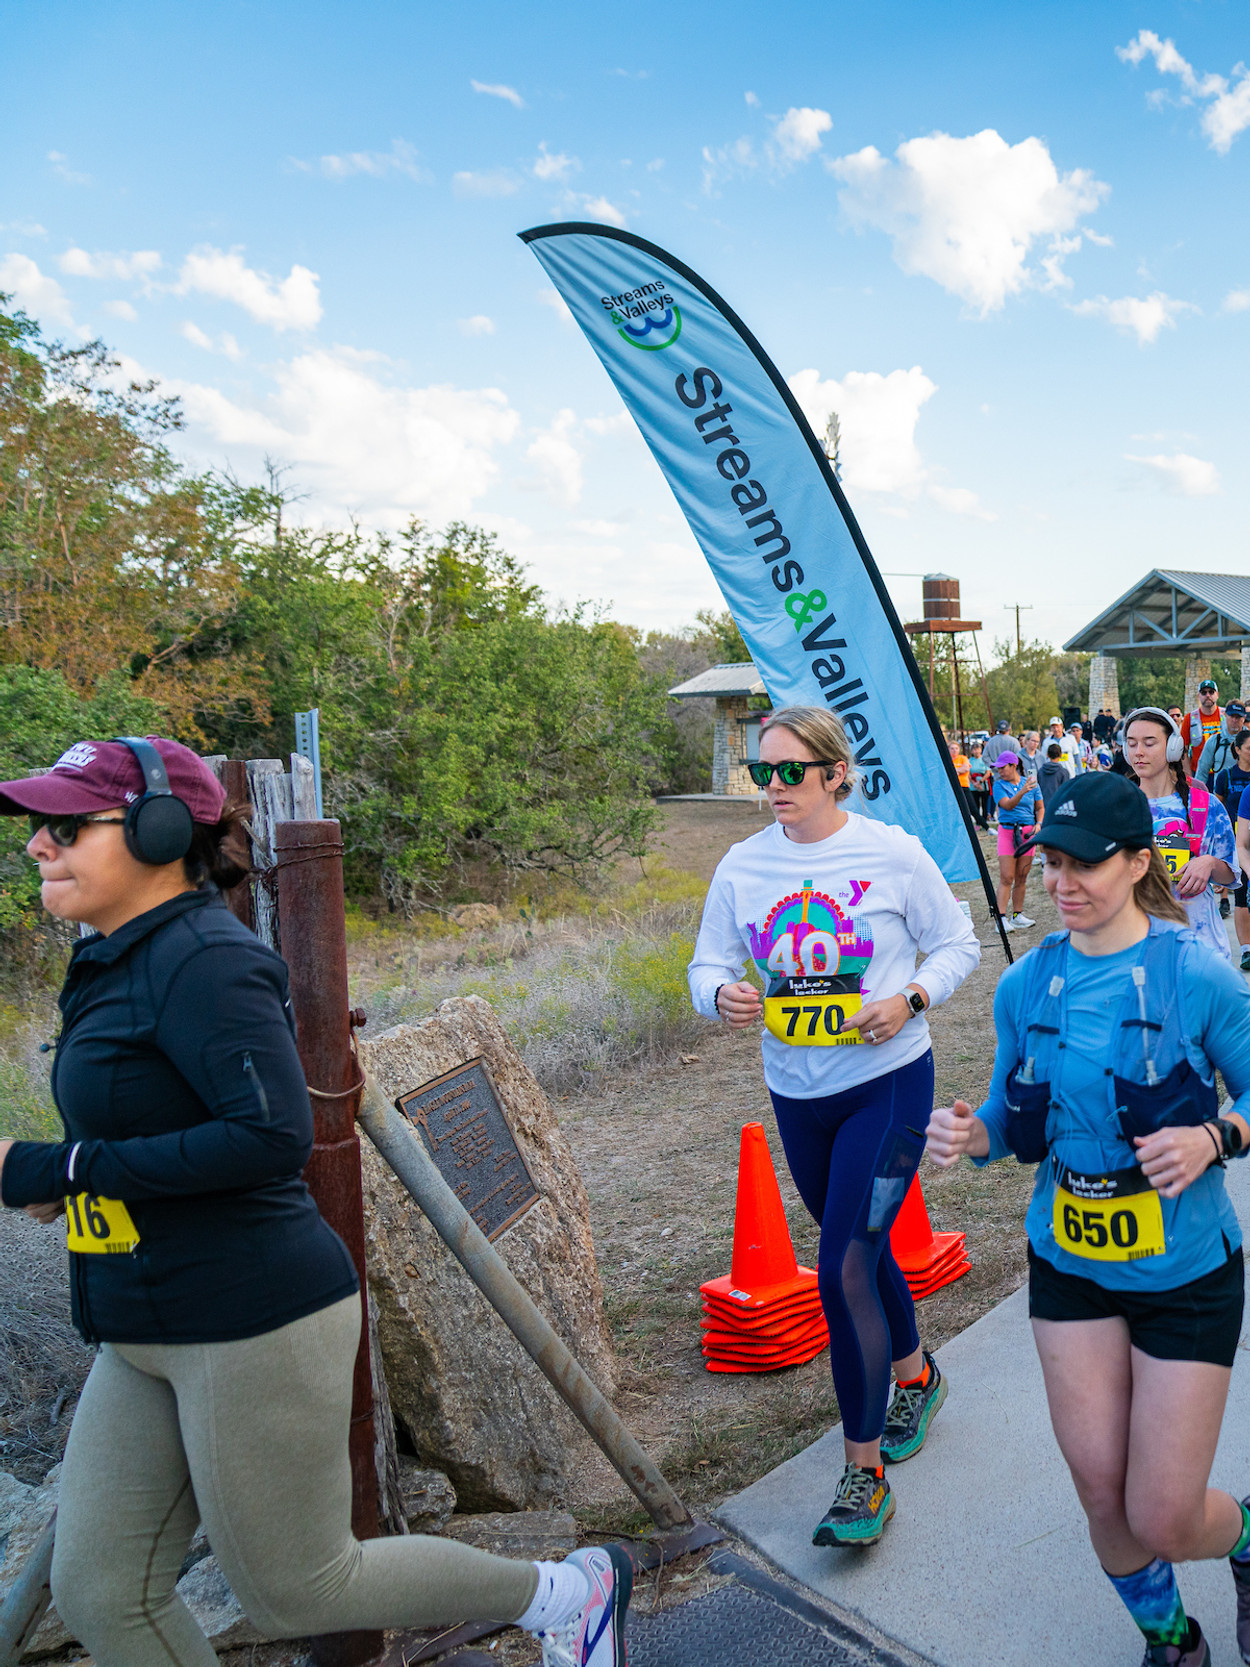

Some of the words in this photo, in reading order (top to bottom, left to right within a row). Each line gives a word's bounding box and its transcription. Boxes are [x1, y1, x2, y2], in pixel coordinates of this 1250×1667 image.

[601, 281, 665, 310] Streams
[788, 979, 832, 990] luke's
[794, 988, 829, 996] locker
[781, 1004, 845, 1037] 770
[1067, 1171, 1118, 1190] luke's
[1072, 1186, 1114, 1199] locker
[67, 1195, 111, 1239] 16
[1063, 1203, 1138, 1248] 650
[867, 1485, 885, 1514] HOKA
